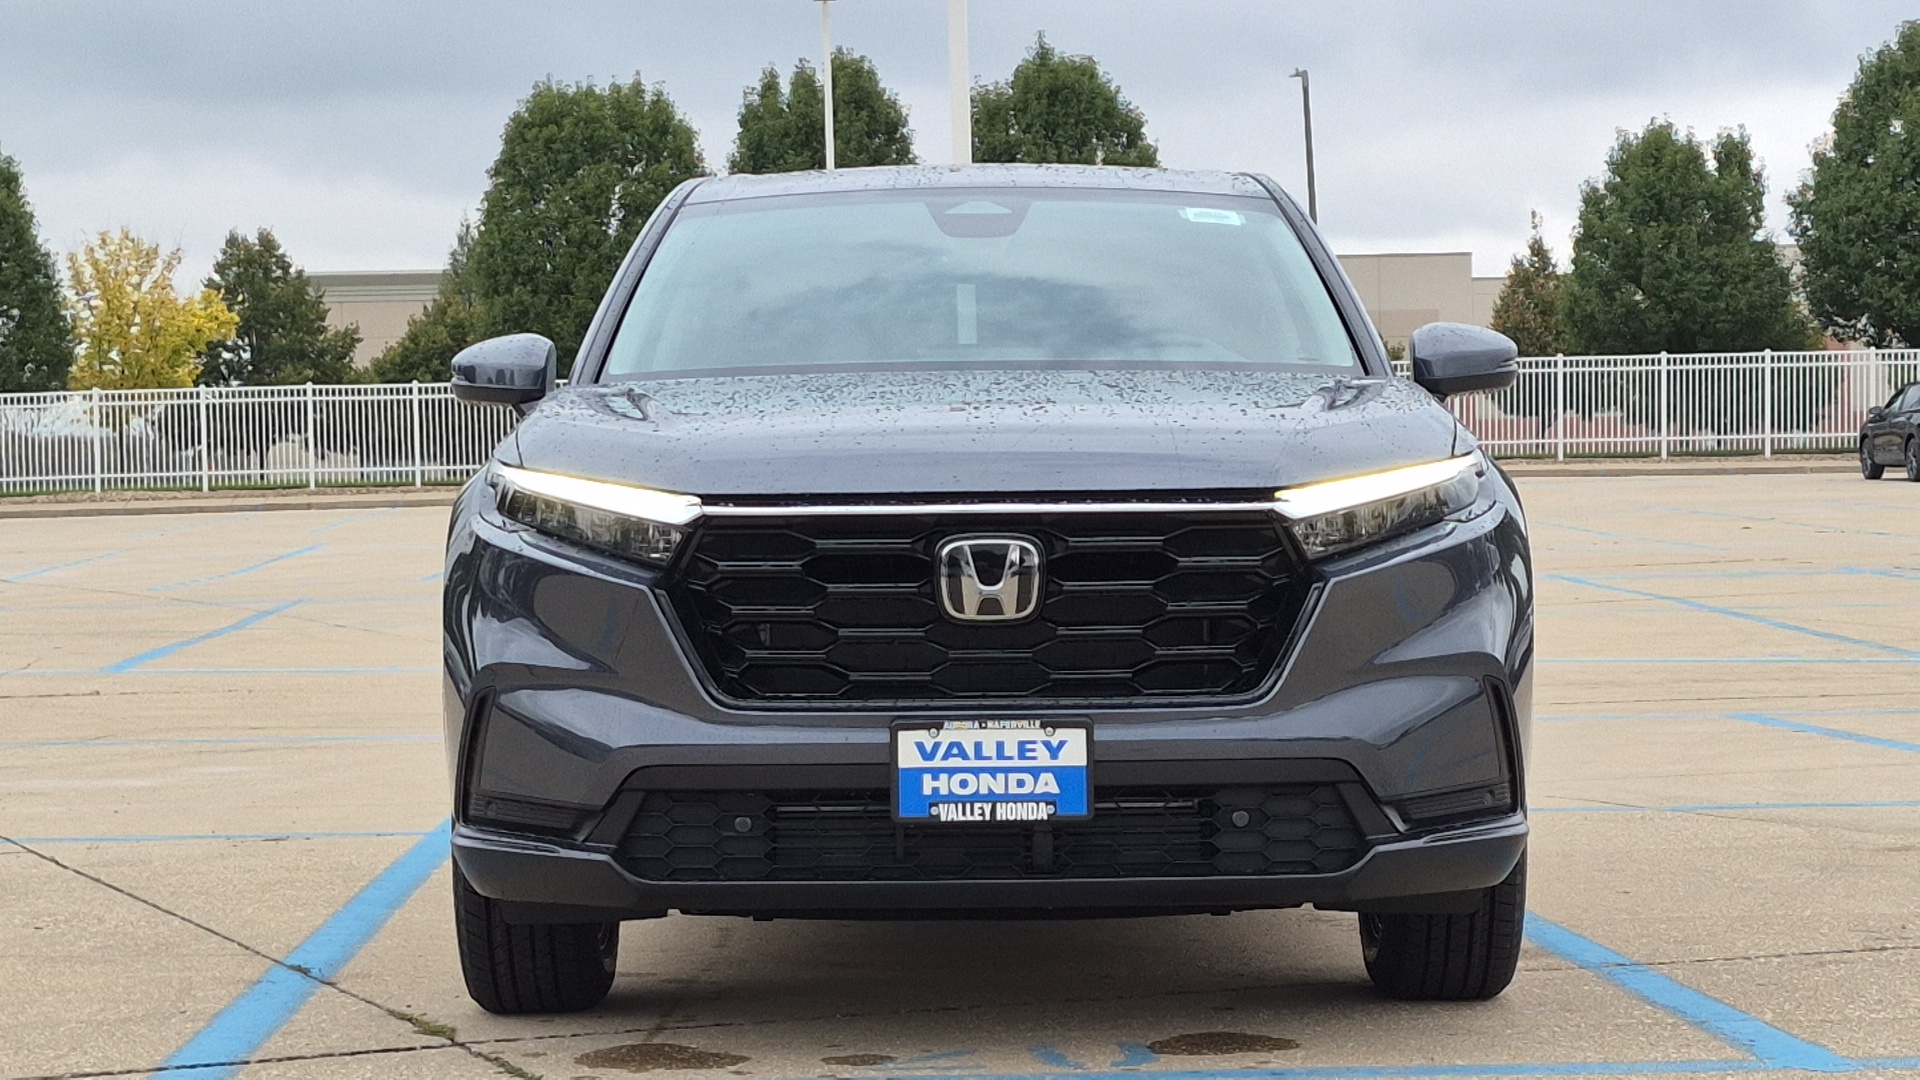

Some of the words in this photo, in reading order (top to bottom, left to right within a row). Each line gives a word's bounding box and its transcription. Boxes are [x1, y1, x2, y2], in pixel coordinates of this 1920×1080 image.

[914, 740, 1068, 762] VALLEY
[922, 772, 1060, 795] HONDA
[938, 802, 992, 821] VALLEY
[996, 802, 1048, 821] HONDA
